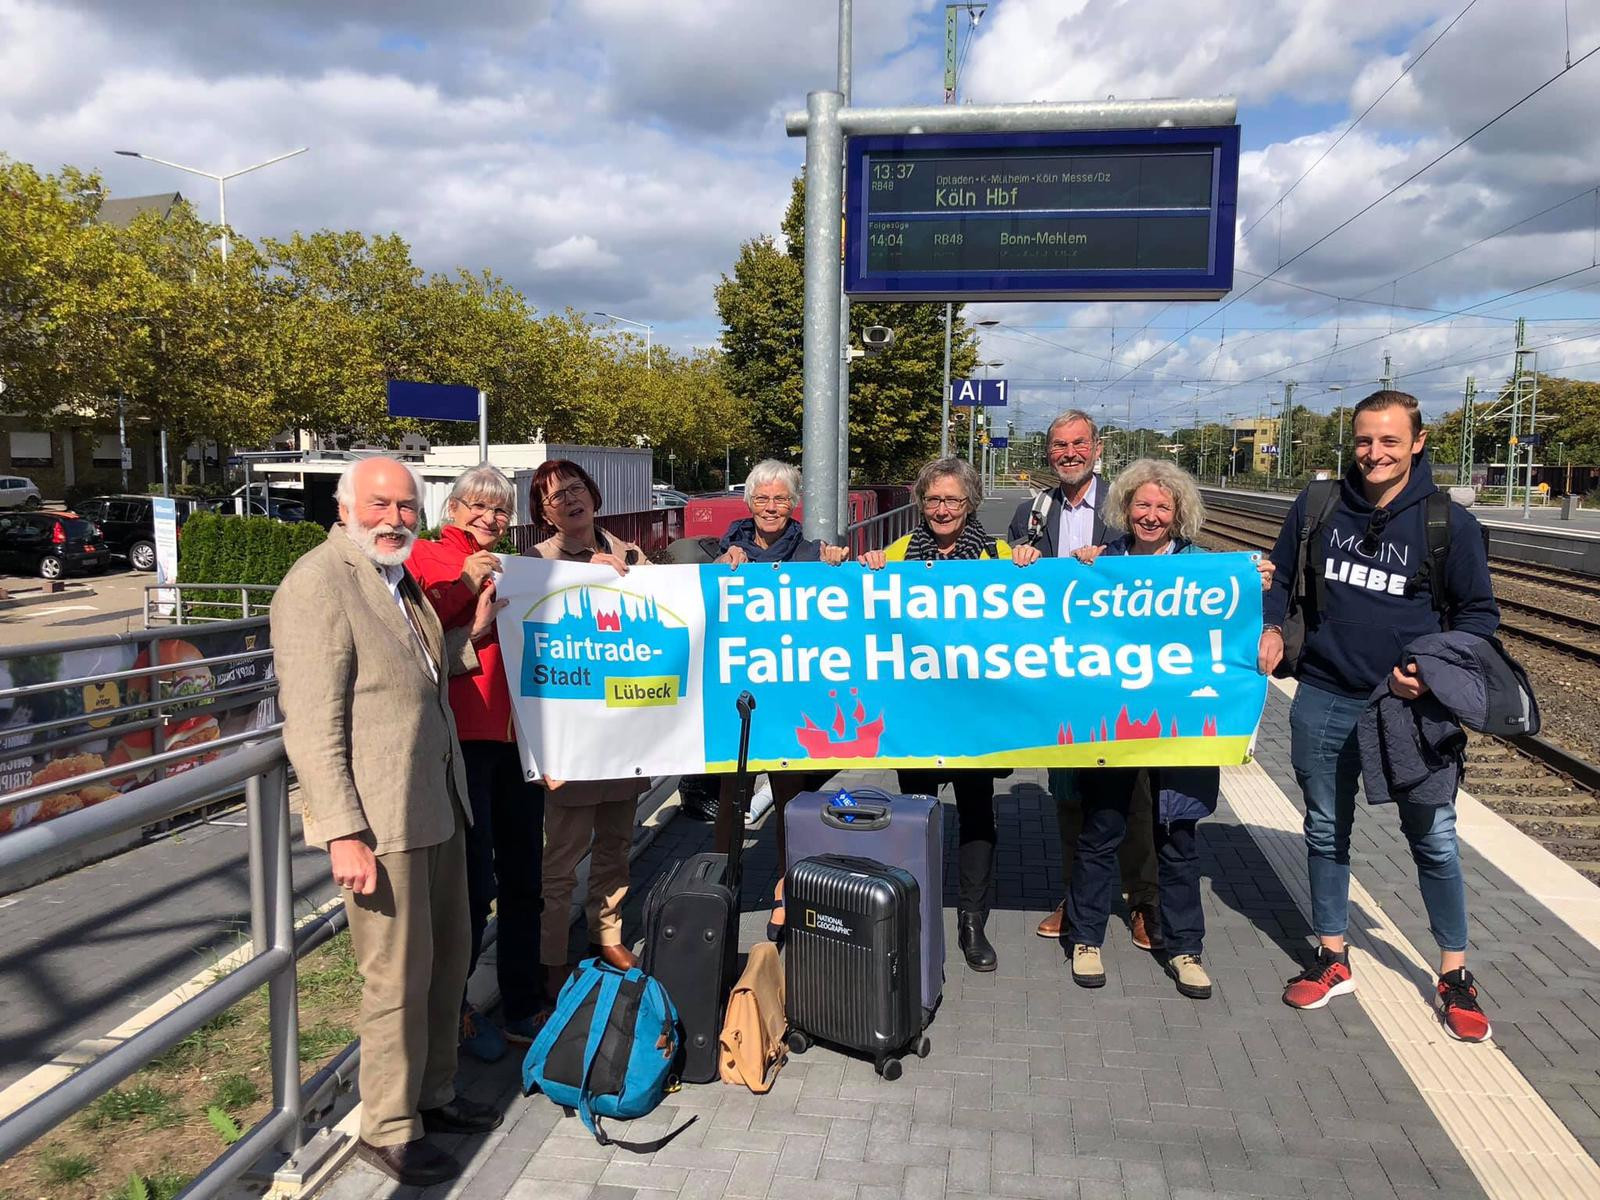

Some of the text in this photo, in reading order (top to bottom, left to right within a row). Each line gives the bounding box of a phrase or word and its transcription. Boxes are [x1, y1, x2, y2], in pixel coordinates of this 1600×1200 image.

[873, 163, 915, 180] 13:37
[1062, 171, 1111, 184] Messe/Dz
[871, 181, 894, 191] RB48
[935, 186, 1018, 207] Köln Hbf
[870, 231, 1087, 247] 14:04 RB48 Bonn-Mehlem
[958, 380, 1005, 401] A 1
[1324, 557, 1408, 596] LIEBE
[718, 573, 1240, 624] Faire Hanse (-städte)
[533, 632, 663, 662] Fairtrade-
[719, 634, 851, 684] Faire
[865, 633, 1193, 690] Hansetage
[532, 664, 591, 687] Stadt
[614, 683, 672, 701] Lübeck
[816, 913, 844, 927] NATIONAL
[816, 920, 851, 936] GEOGRAPHIC
